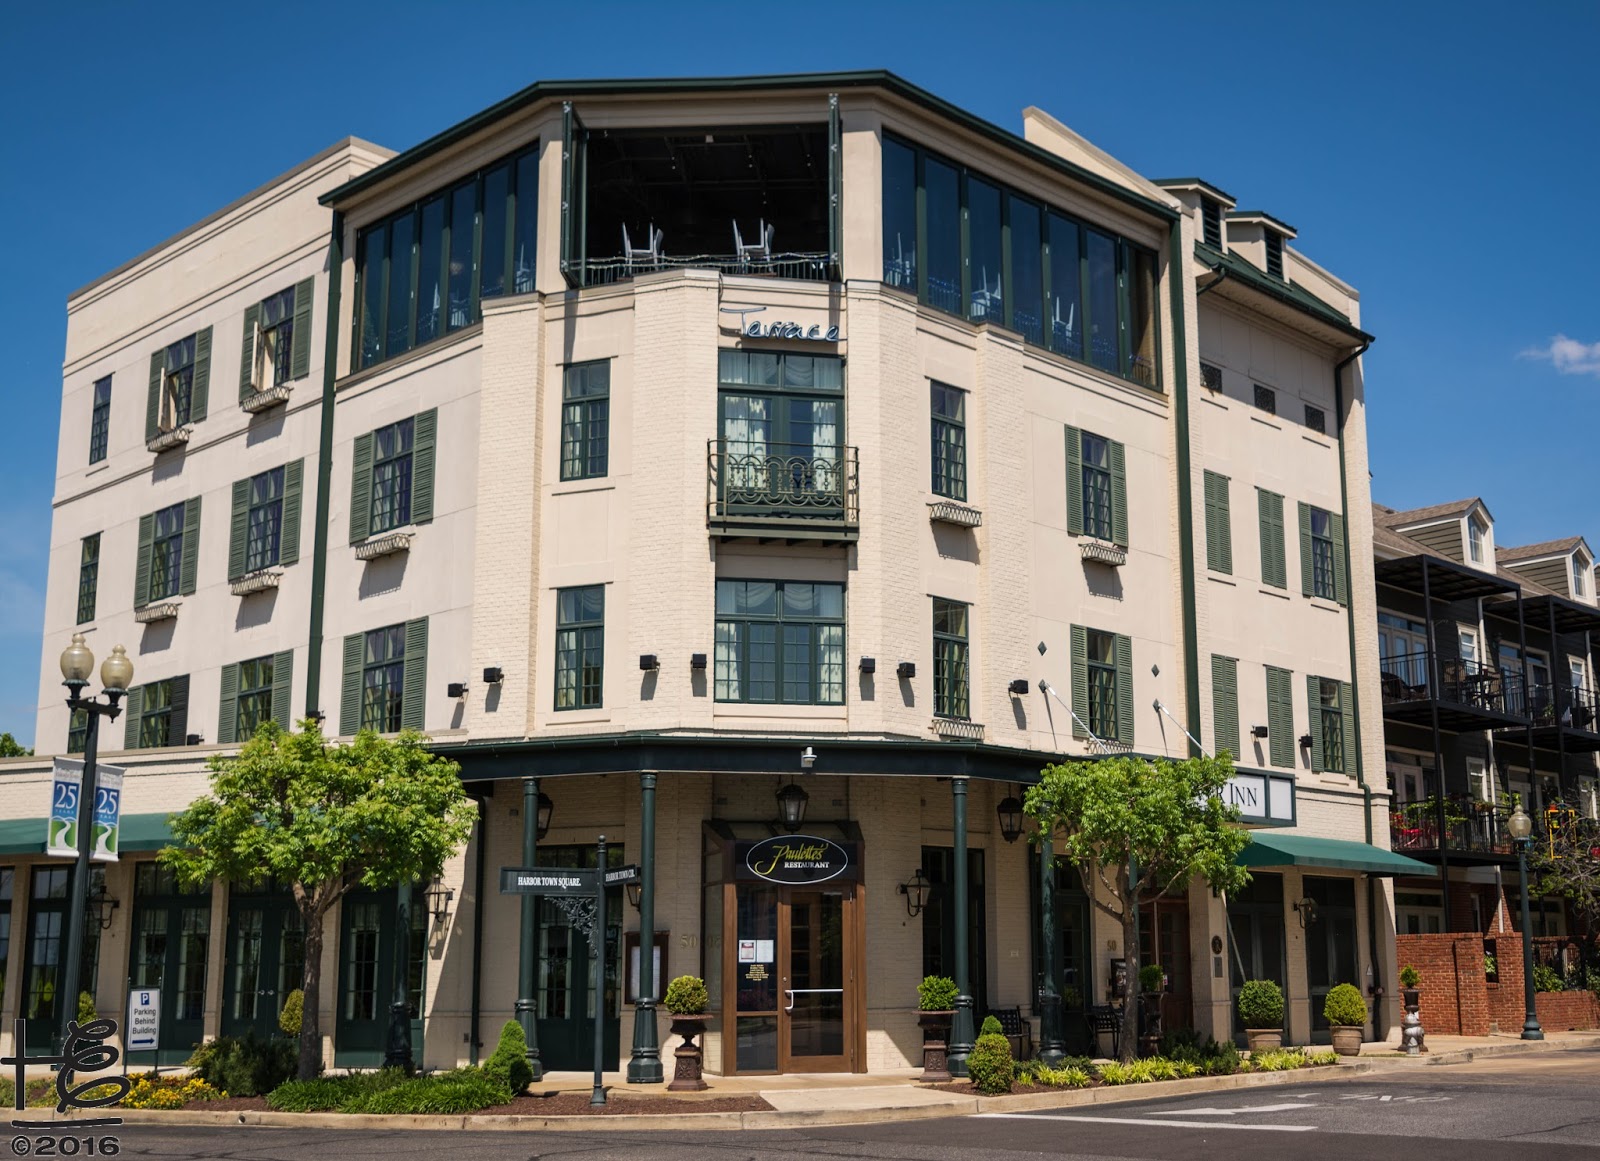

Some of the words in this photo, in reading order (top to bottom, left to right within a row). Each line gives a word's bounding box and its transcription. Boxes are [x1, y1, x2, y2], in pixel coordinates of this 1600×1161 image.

[720, 307, 839, 342] Terrace
[55, 784, 77, 809] 25
[1229, 783, 1257, 807] INN
[96, 790, 118, 814] 25
[784, 861, 829, 869] RESTAURANT
[518, 876, 541, 886] HARBOR
[542, 877, 558, 886] TOWN
[605, 871, 618, 882] HARBOR
[619, 869, 628, 879] TOWN
[680, 934, 698, 948] 50
[134, 1008, 156, 1017] Parking
[135, 1017, 155, 1025] Behind
[133, 1027, 157, 1035] Building
